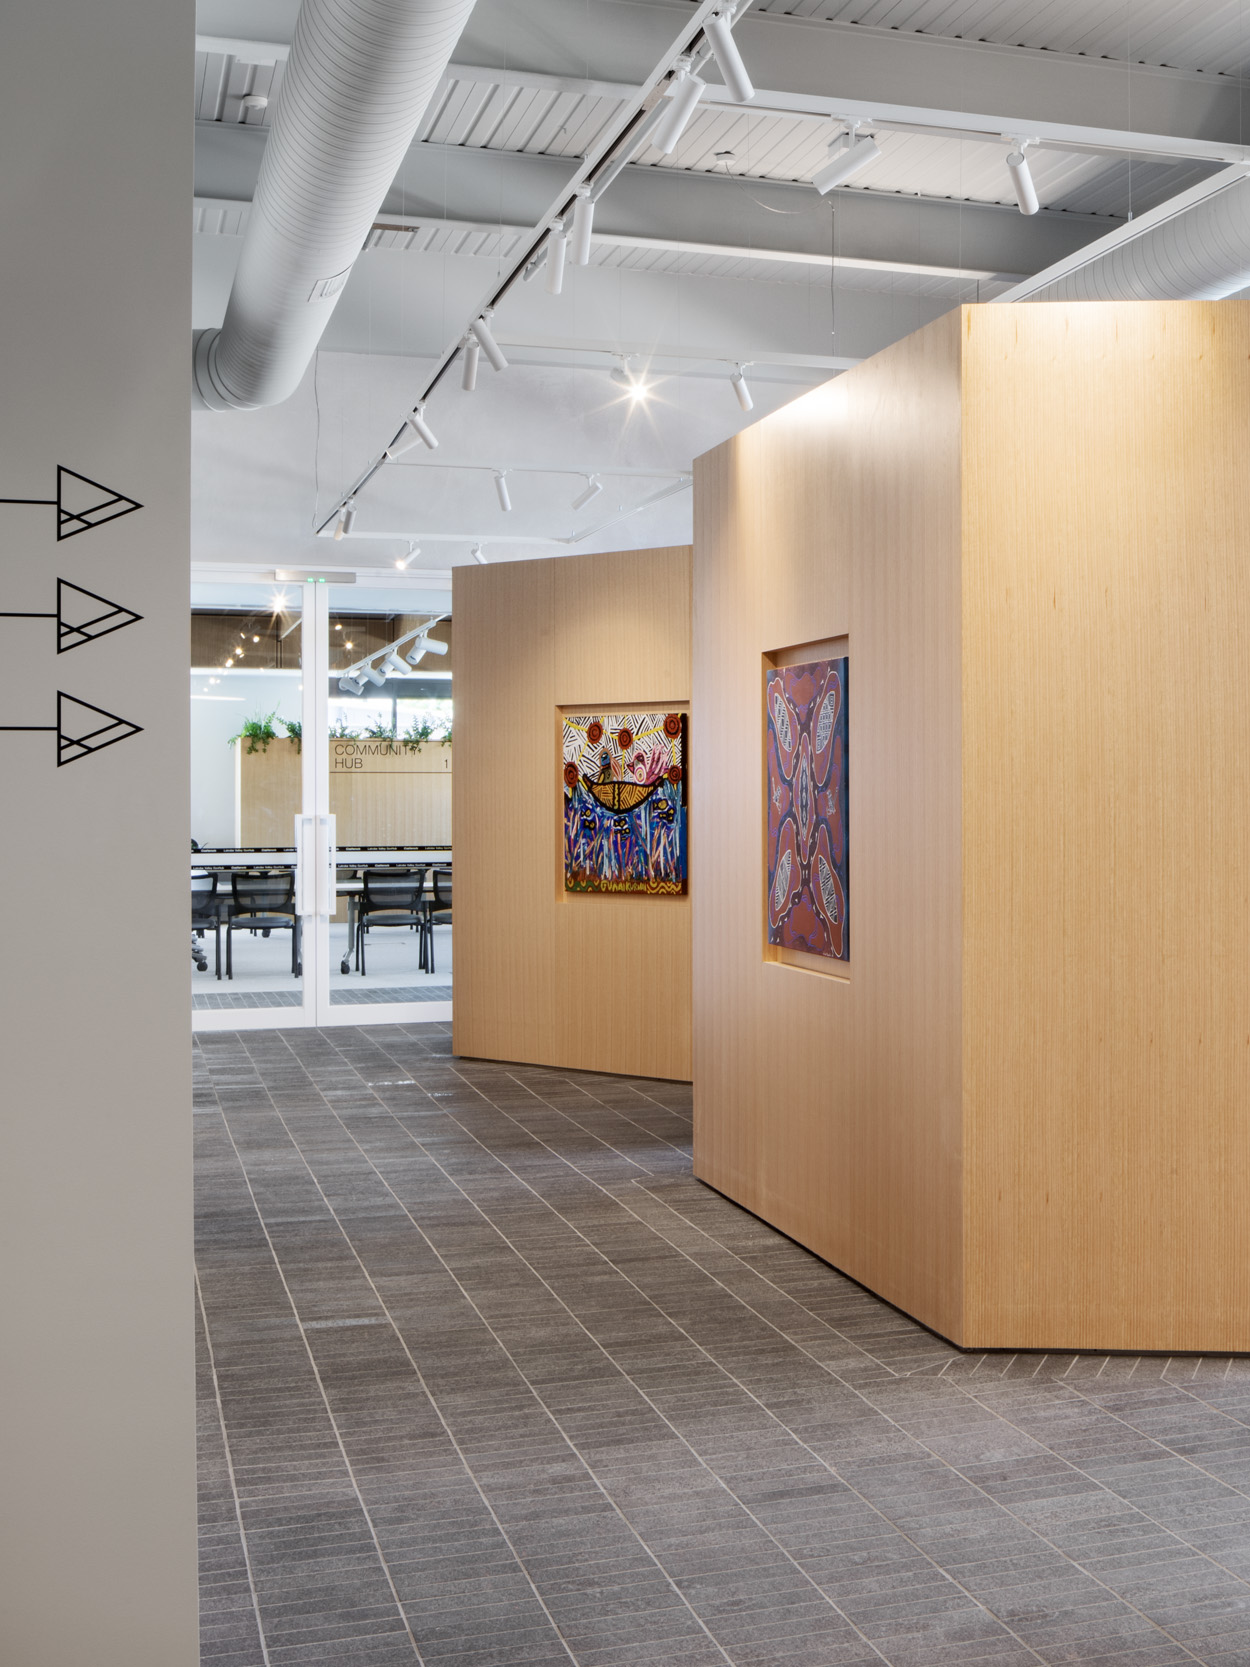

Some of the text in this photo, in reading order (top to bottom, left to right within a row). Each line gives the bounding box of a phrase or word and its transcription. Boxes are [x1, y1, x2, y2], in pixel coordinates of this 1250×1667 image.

[334, 744, 418, 756] COMMUNITY
[334, 758, 448, 769] HUB 1
